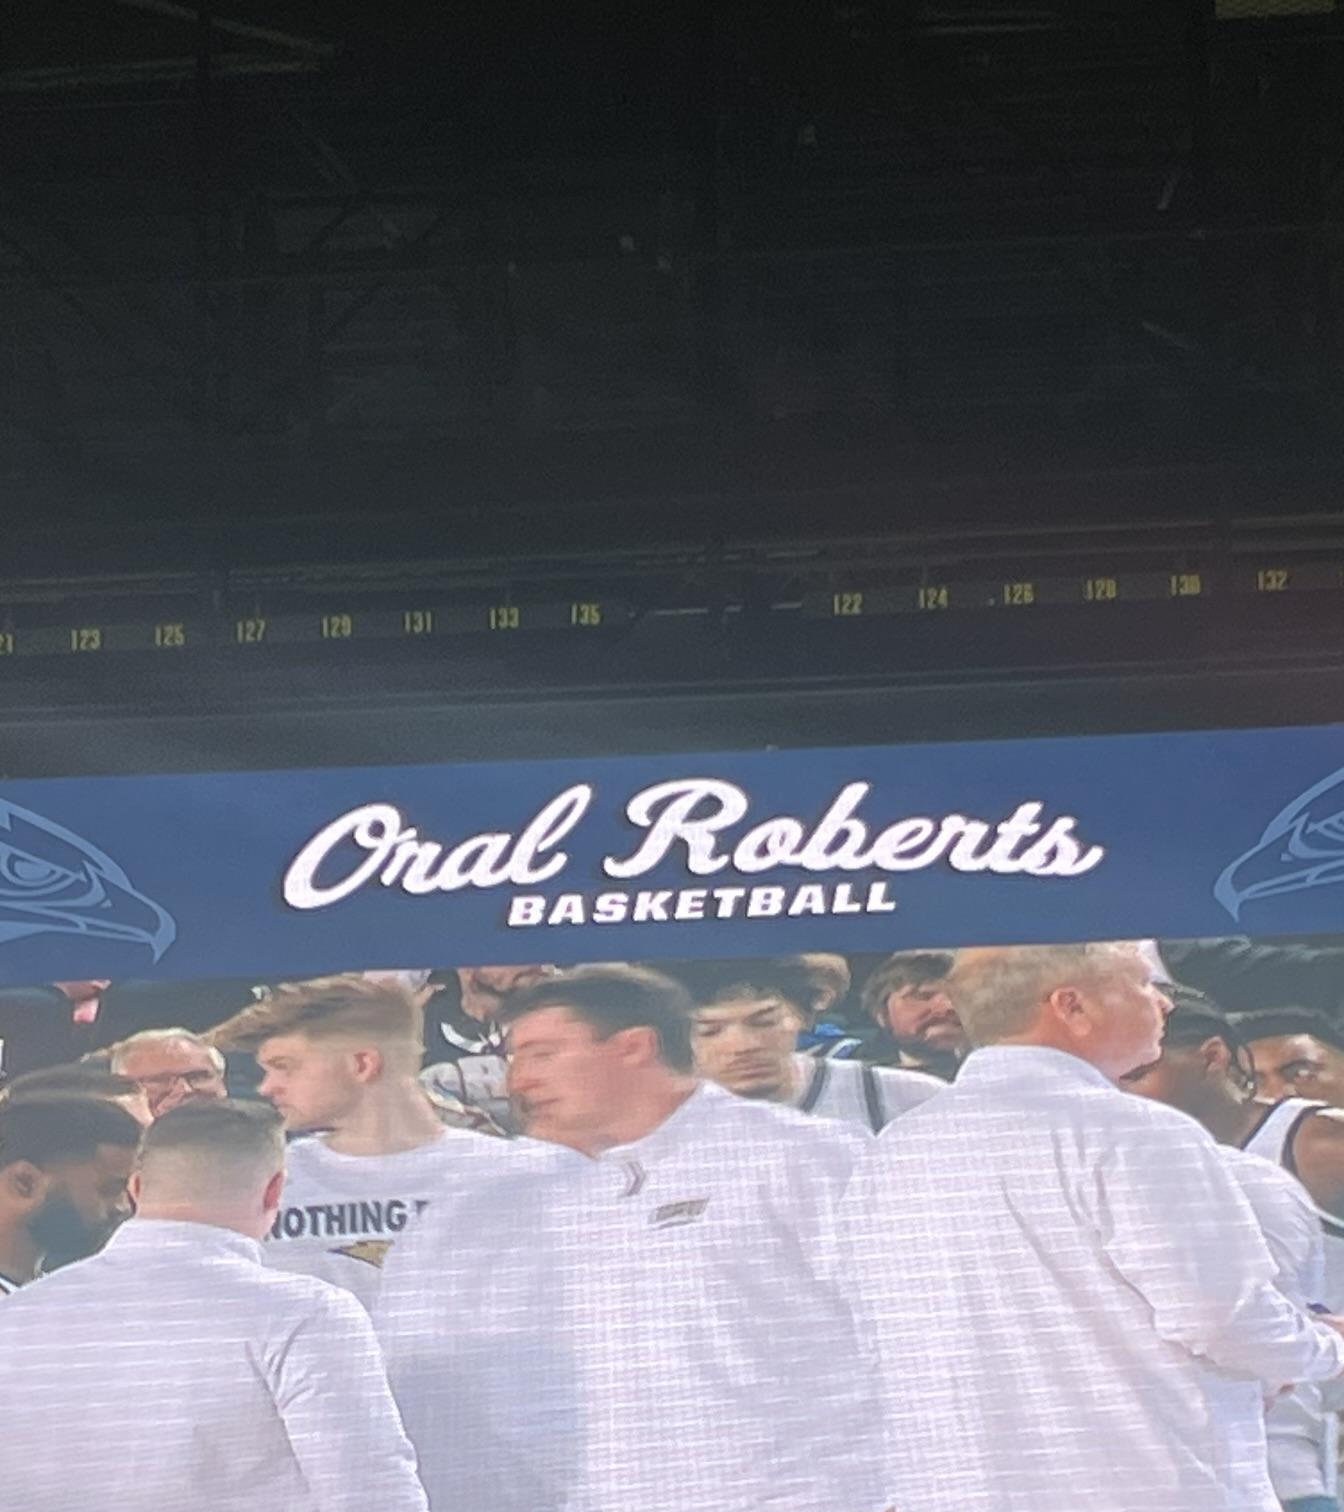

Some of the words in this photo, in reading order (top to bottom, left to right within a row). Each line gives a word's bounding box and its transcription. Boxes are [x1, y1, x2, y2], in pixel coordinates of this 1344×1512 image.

[1256, 569, 1288, 592] 132
[832, 593, 863, 615] 122
[918, 587, 949, 610] 124
[404, 611, 432, 634] 131
[489, 608, 520, 630] 133
[571, 603, 601, 626] 135
[71, 628, 102, 651] 123
[154, 624, 186, 647] 125
[283, 782, 595, 911] Oral
[602, 776, 1104, 878] Roberts
[508, 882, 898, 928] BASKETBALL
